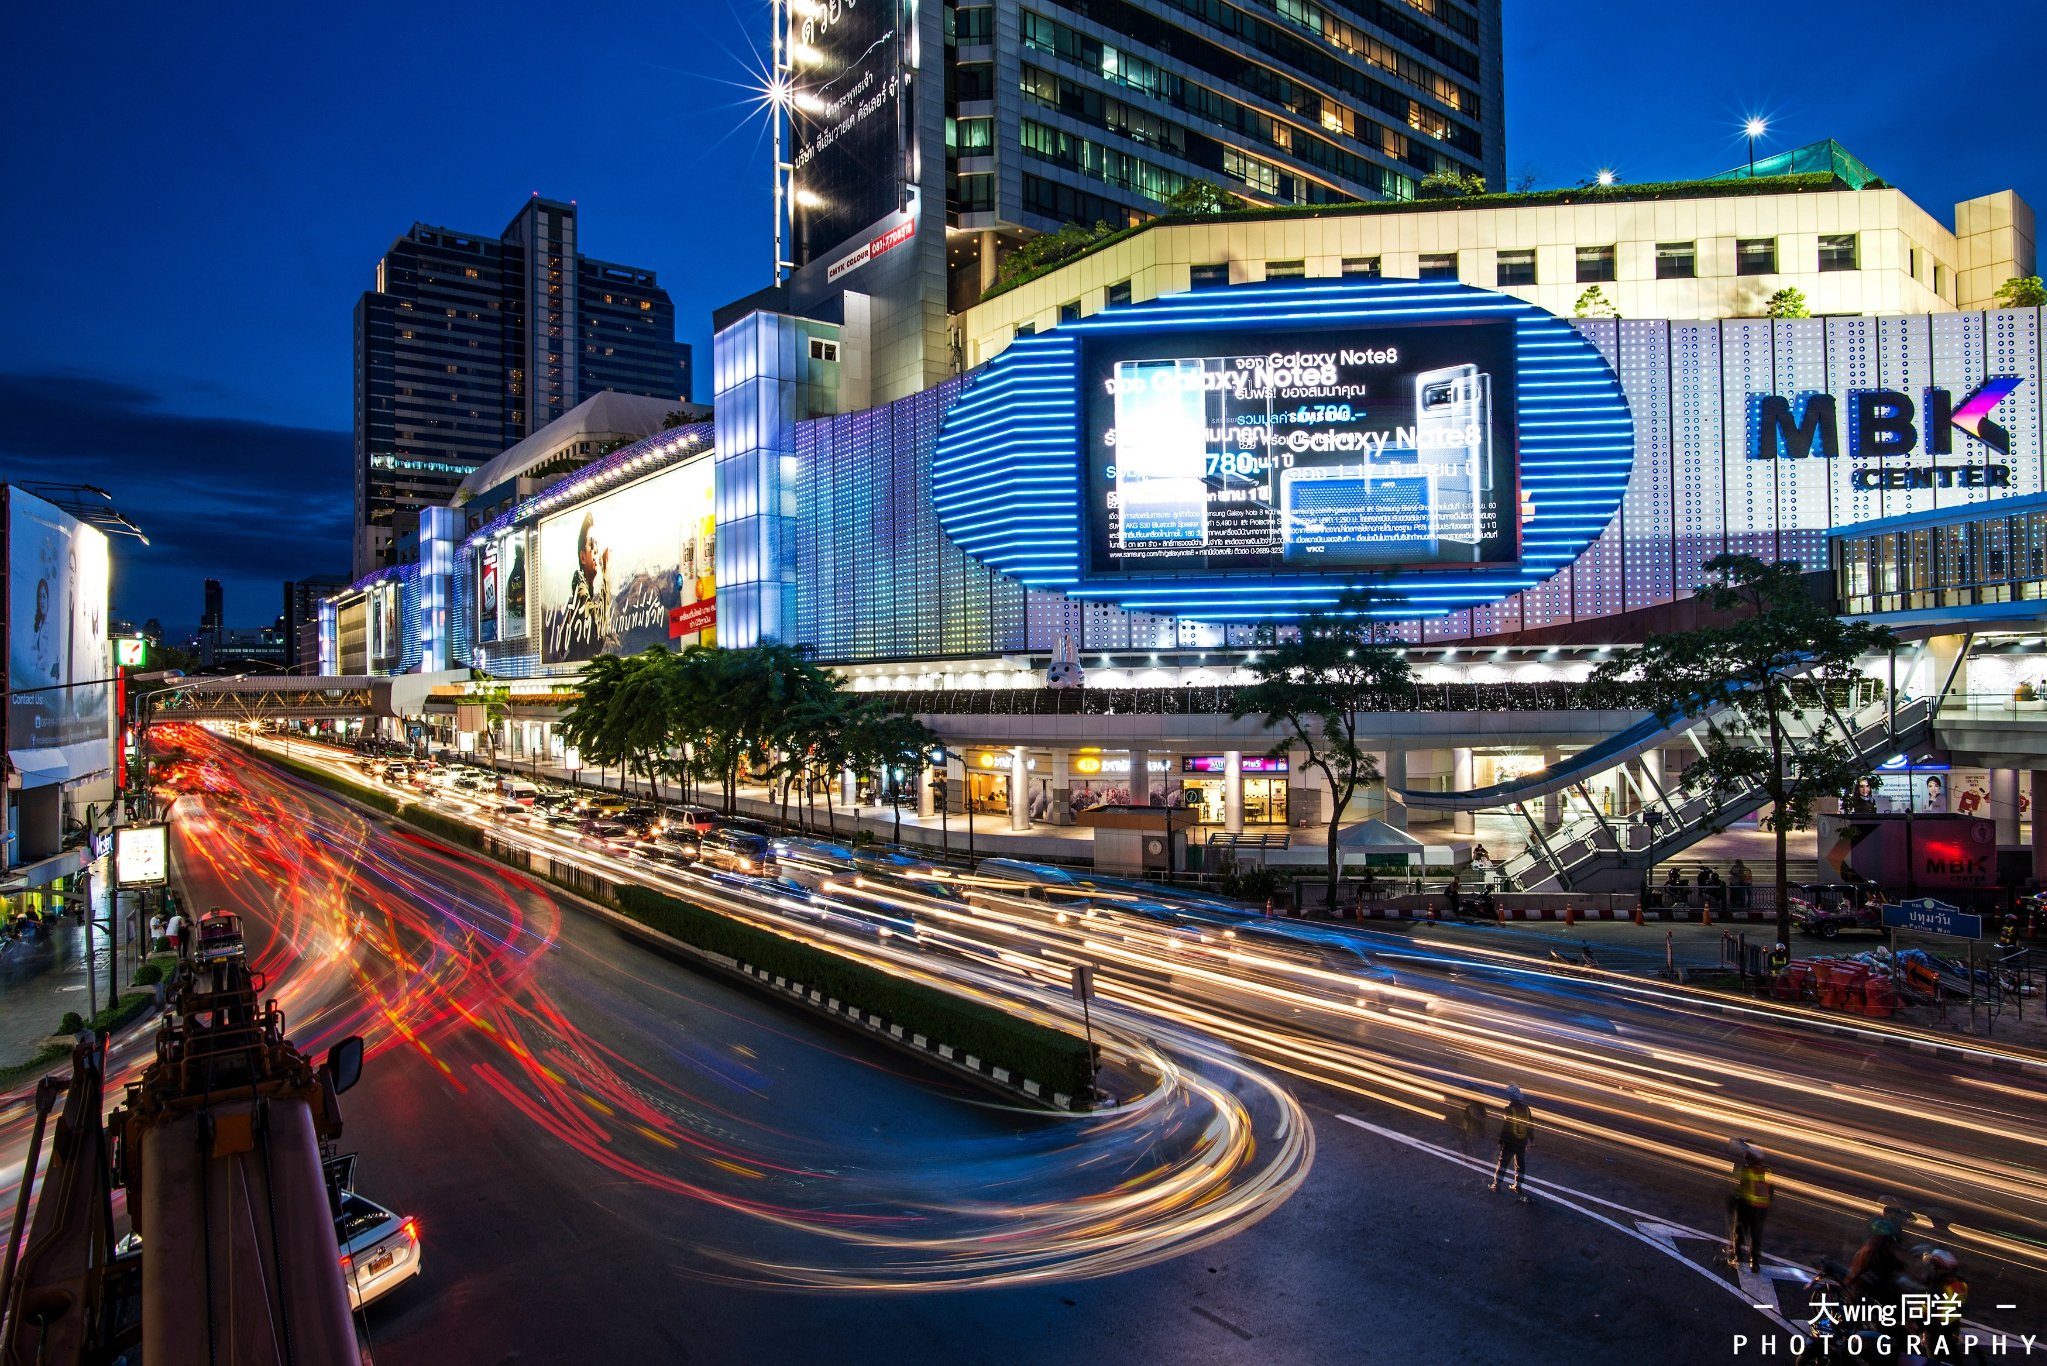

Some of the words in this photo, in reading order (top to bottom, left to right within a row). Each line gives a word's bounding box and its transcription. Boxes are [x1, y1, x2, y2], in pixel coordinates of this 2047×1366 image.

[829, 263, 845, 278] CMYK
[847, 250, 869, 269] COLOUR
[1236, 358, 1263, 369] จอง
[1268, 351, 1337, 370] Galaxy
[1341, 347, 1398, 365] Note8
[1254, 364, 1338, 389] Note8
[1281, 384, 1366, 400] ของสมนาคุณ
[1745, 374, 2026, 459] MBK
[1288, 428, 1389, 457] Galaxy
[1396, 424, 1482, 450] Note8
[1849, 465, 2012, 490] CENTER
[1226, 509, 1244, 518] Galaxy
[12, 694, 35, 705] Contact
[1926, 855, 1990, 875] MBK
[1950, 875, 1987, 883] CENTER
[1909, 911, 1951, 926] ปทุมวัน
